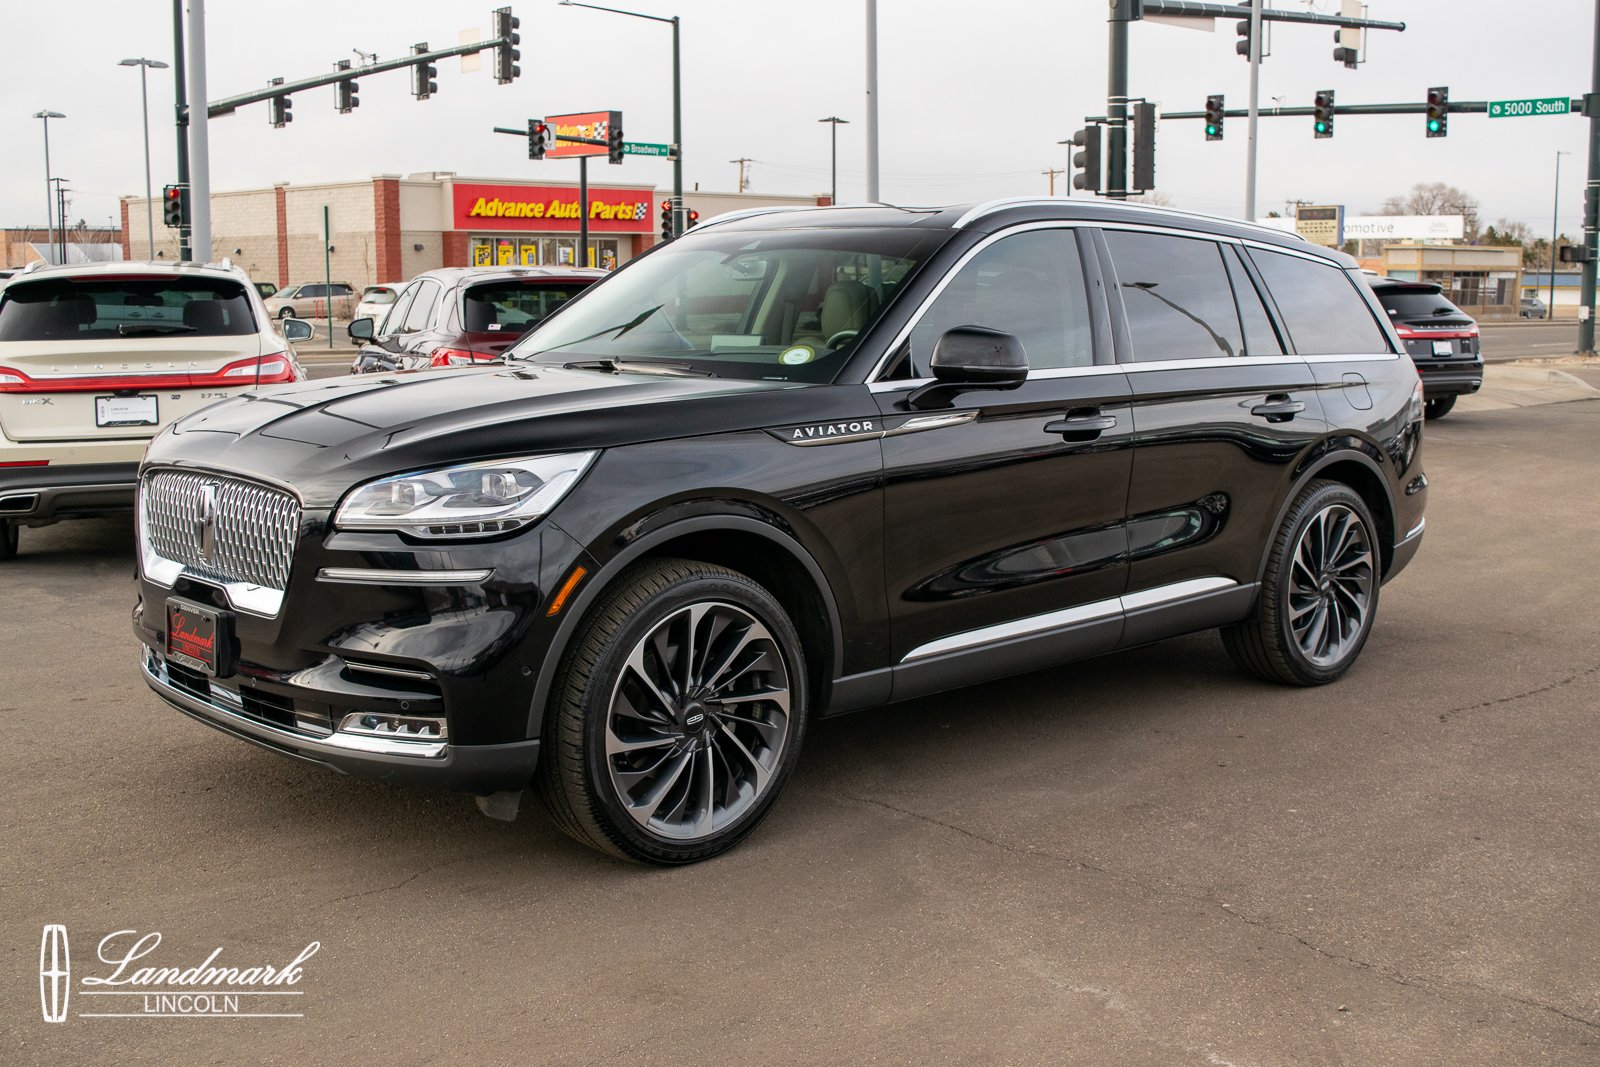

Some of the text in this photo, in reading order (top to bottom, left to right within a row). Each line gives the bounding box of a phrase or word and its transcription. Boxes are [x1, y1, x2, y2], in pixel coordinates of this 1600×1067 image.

[1504, 100, 1566, 115] 5000 South
[631, 144, 659, 155] Broadway
[471, 198, 543, 216] Advance
[590, 201, 634, 219] Parts
[53, 362, 198, 371] LINCOLN
[793, 421, 873, 438] AVIATOR
[181, 604, 199, 614] DENVER
[171, 613, 214, 648] Landmark
